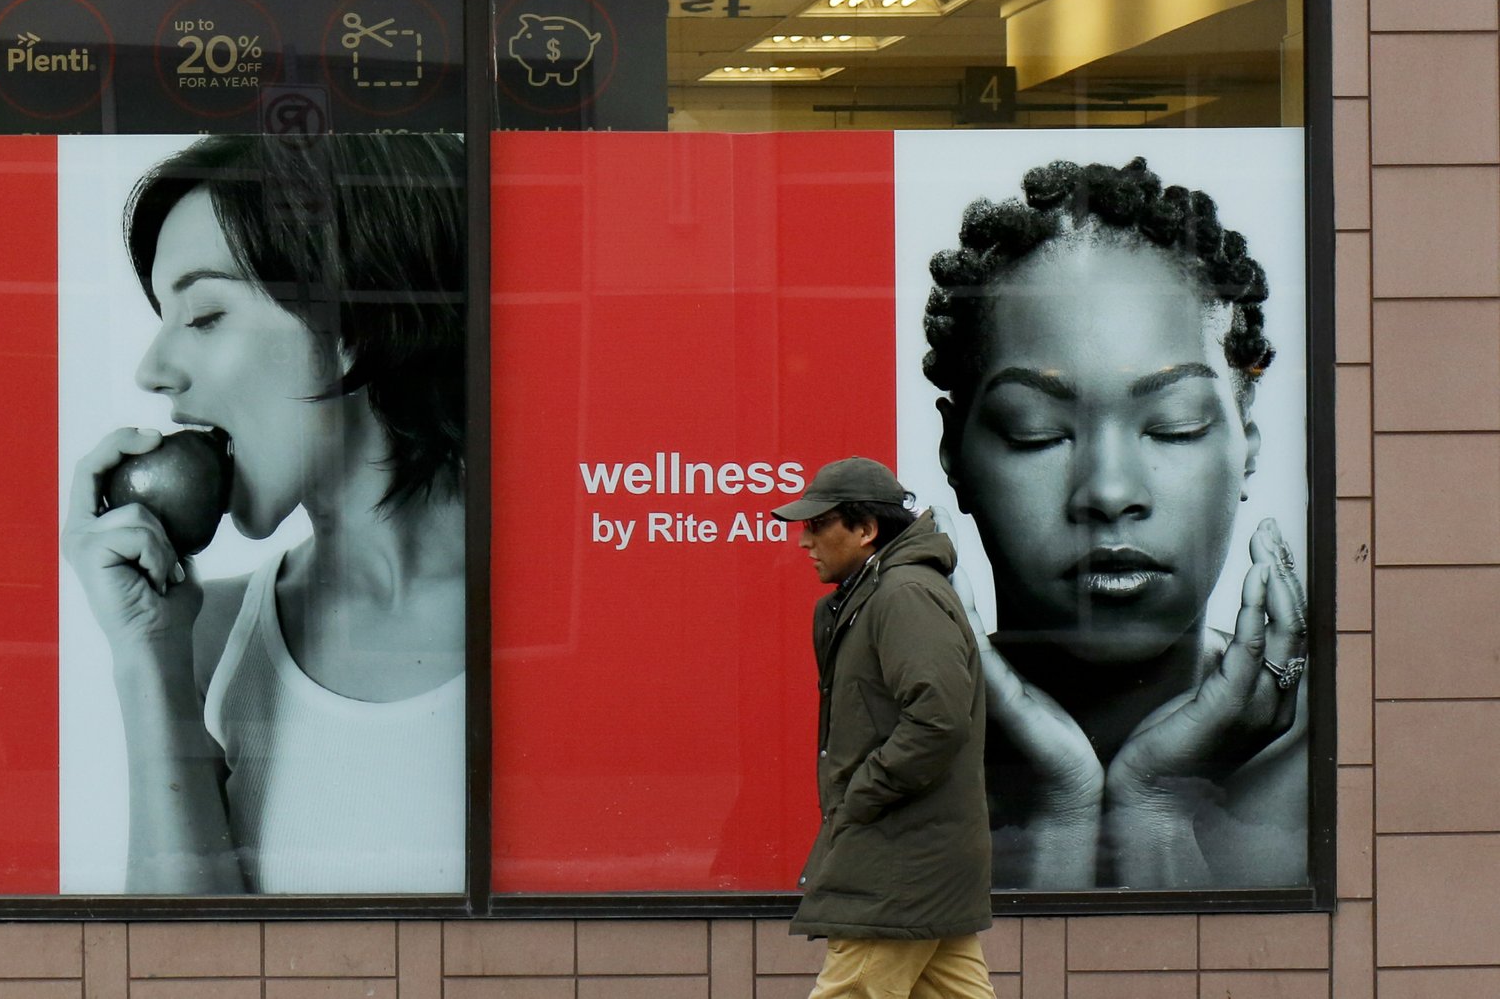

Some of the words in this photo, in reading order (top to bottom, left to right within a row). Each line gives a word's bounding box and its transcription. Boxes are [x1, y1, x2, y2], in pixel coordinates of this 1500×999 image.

[174, 21, 195, 34] up
[198, 18, 215, 31] to
[237, 62, 263, 73] OFF
[179, 77, 207, 88] FOR
[210, 77, 219, 88] A
[222, 77, 260, 88] YEAR
[979, 75, 1002, 111] 4
[579, 452, 805, 495] wellness
[592, 513, 636, 550] by
[648, 512, 717, 543] Rite
